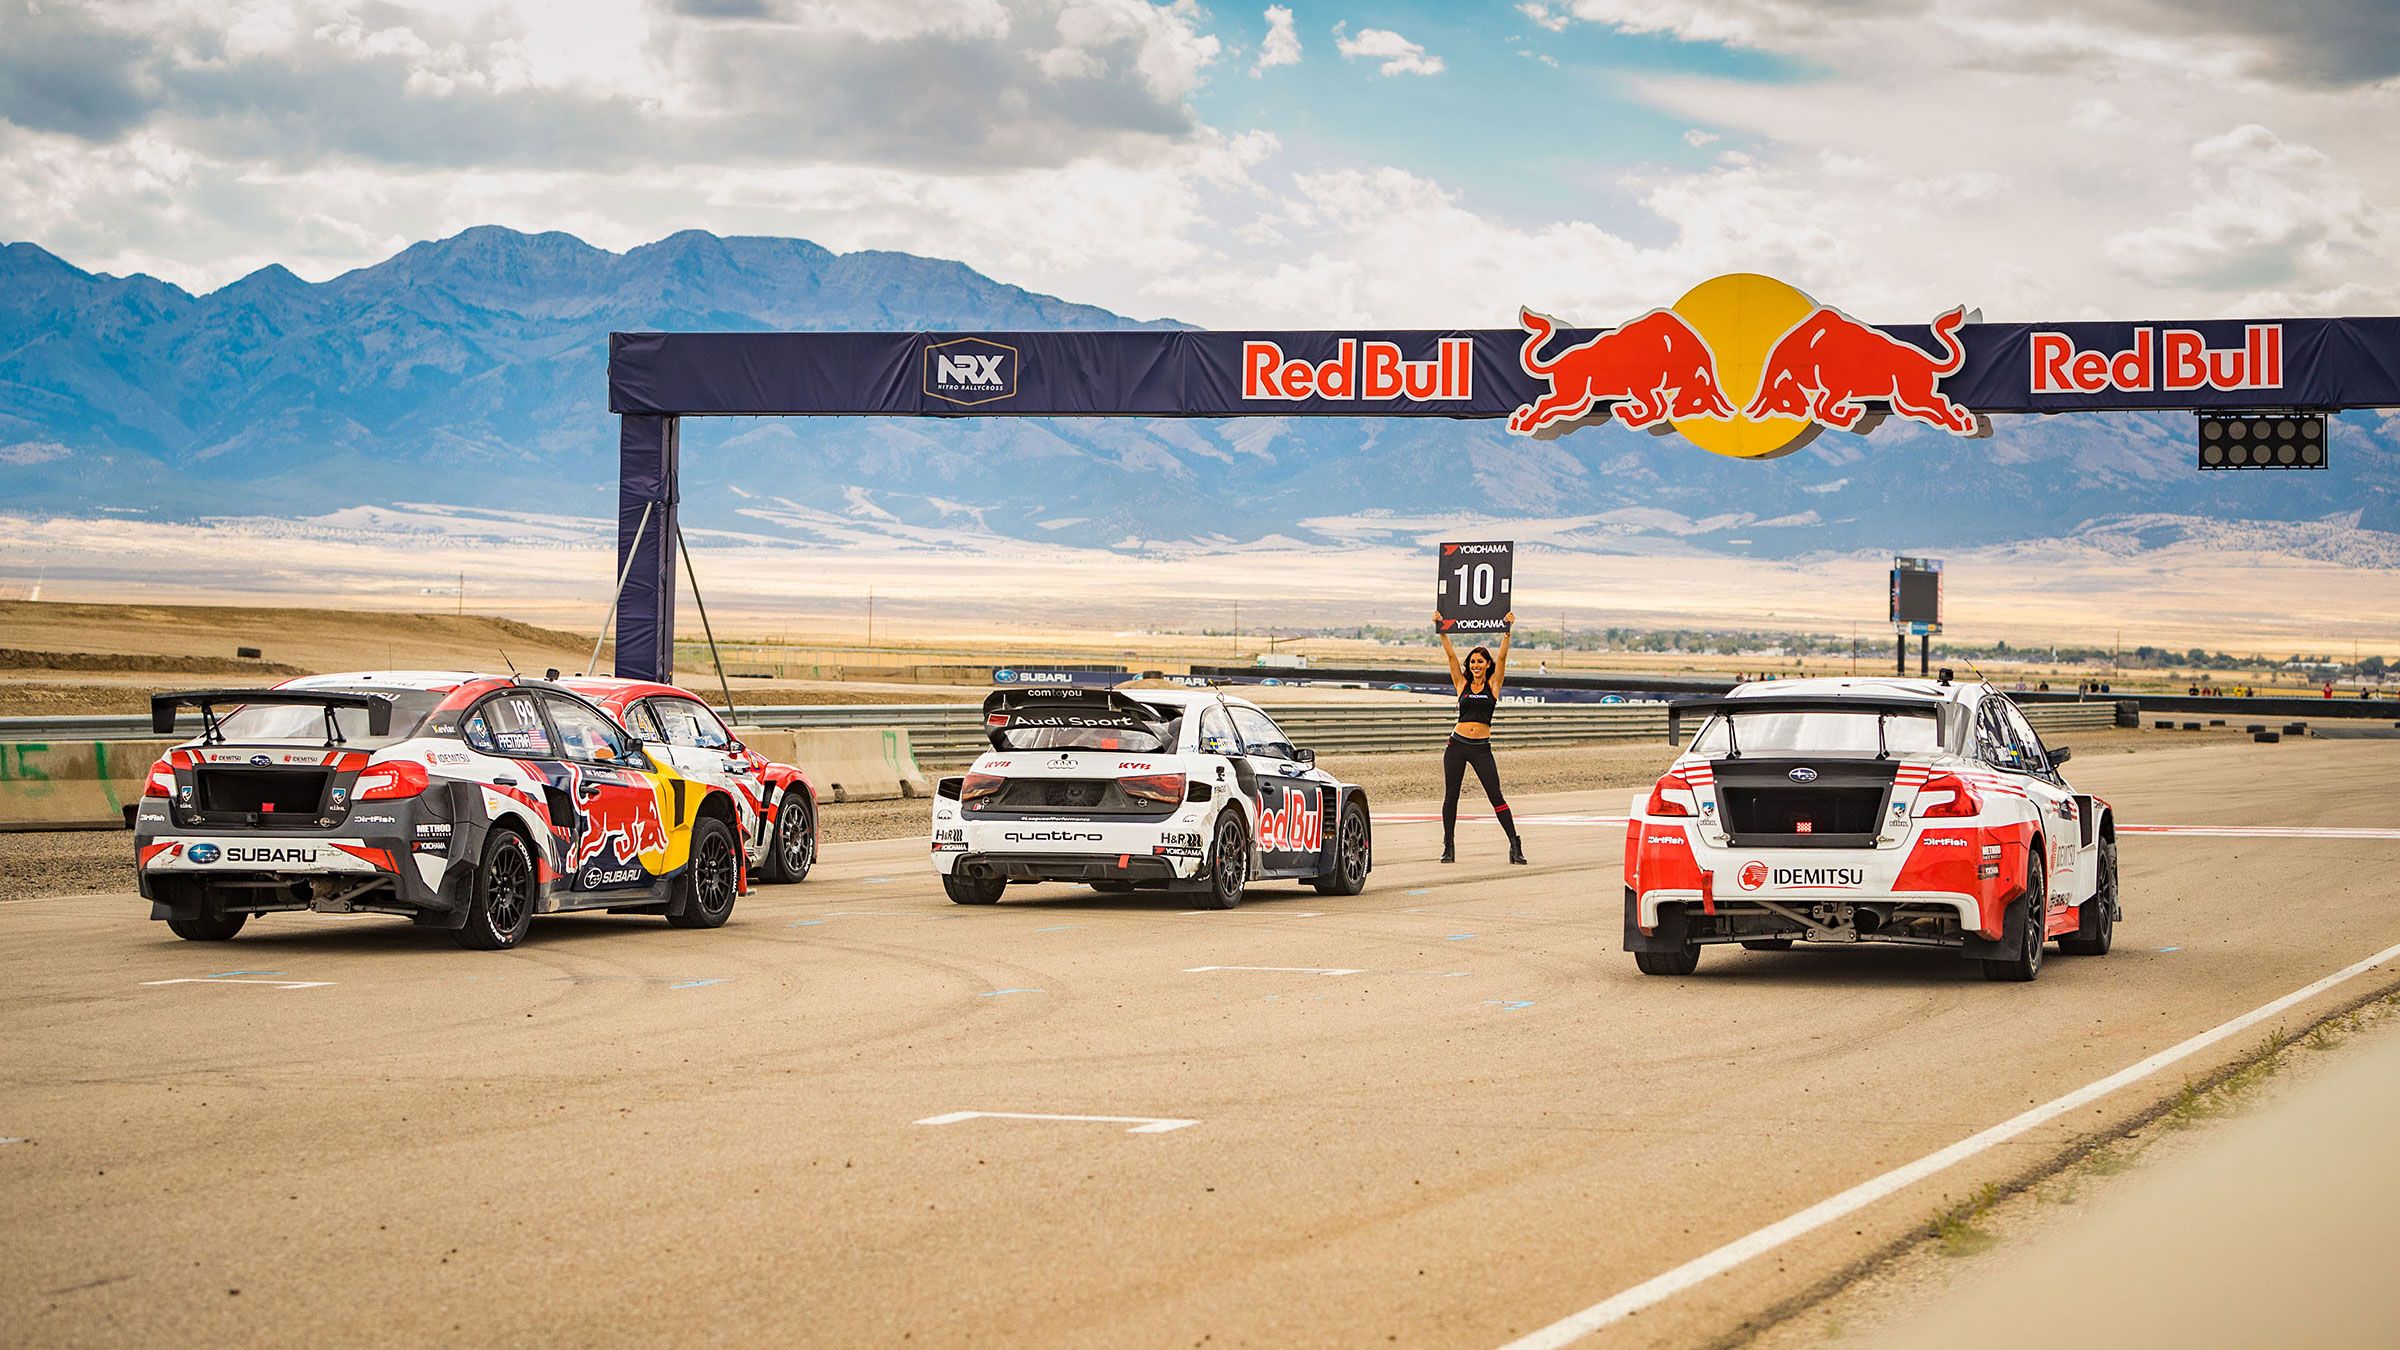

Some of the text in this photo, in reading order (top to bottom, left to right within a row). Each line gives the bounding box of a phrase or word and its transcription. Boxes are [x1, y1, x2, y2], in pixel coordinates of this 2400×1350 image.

[2030, 324, 2283, 393] Red Bull
[938, 355, 1004, 385] NRX
[1242, 338, 1473, 401] Red Bull
[1459, 544, 1508, 554] YOKOHAMA
[1454, 563, 1494, 606] 10
[1455, 619, 1505, 629] YOKOHAMA
[1019, 672, 1073, 683] SUBARU
[1027, 689, 1082, 698] comtoyou
[510, 700, 536, 726] 199
[1014, 716, 1134, 727] Audi Sport
[437, 753, 471, 763] IDEMITSU
[416, 824, 452, 833] METHOD
[1004, 831, 1103, 843] quattro
[1161, 832, 1186, 845] H&R
[1647, 835, 1685, 845] DirtFish
[1923, 837, 1968, 847] DirtFish
[420, 842, 447, 850] YOKOHAMA
[227, 848, 317, 863] SUBARU
[602, 869, 642, 884] SUBARU
[1773, 868, 1863, 884] IDEMITSU
